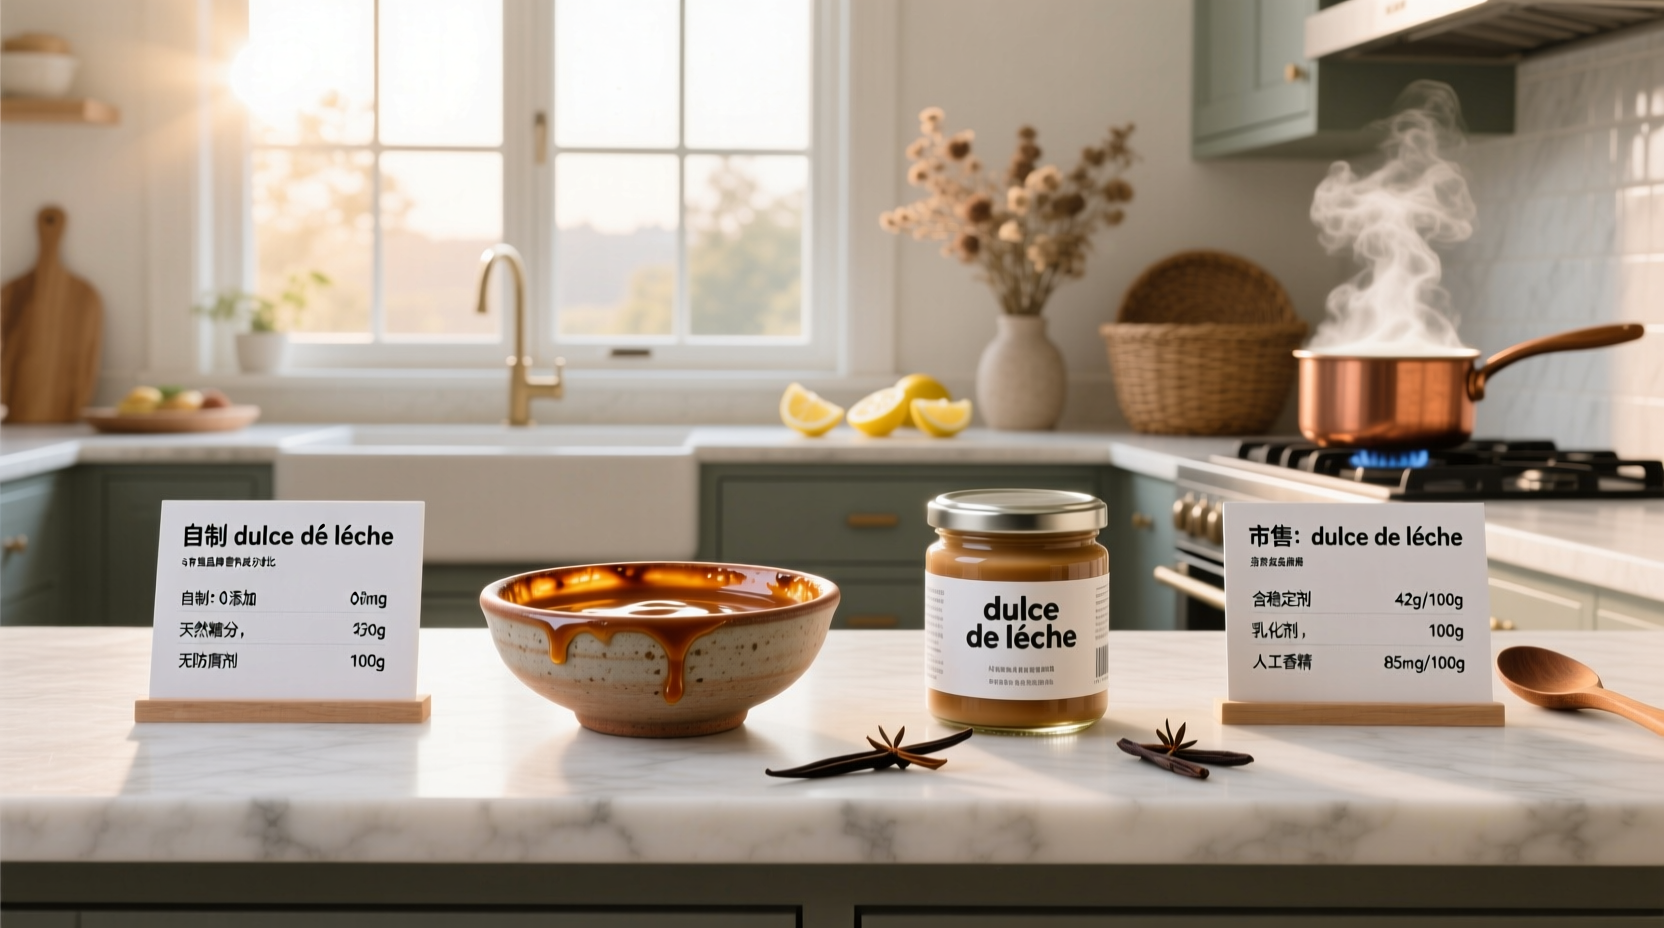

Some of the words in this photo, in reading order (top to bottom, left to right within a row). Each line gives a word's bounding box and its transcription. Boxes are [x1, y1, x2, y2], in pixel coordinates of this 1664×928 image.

[183, 522, 228, 549] 自制
[233, 524, 295, 546] dulce
[300, 523, 329, 546] dé
[334, 524, 394, 546] léche
[1311, 525, 1369, 547] dulce
[1374, 525, 1401, 547] de
[1406, 525, 1464, 547] léche
[983, 595, 1060, 621] dulce
[1394, 591, 1464, 610] 42g/100g
[966, 623, 1000, 649] de
[1006, 623, 1077, 649] léche
[1428, 623, 1464, 641] 100g
[350, 653, 386, 672] 100g
[1384, 654, 1466, 674] 85mg/100g
